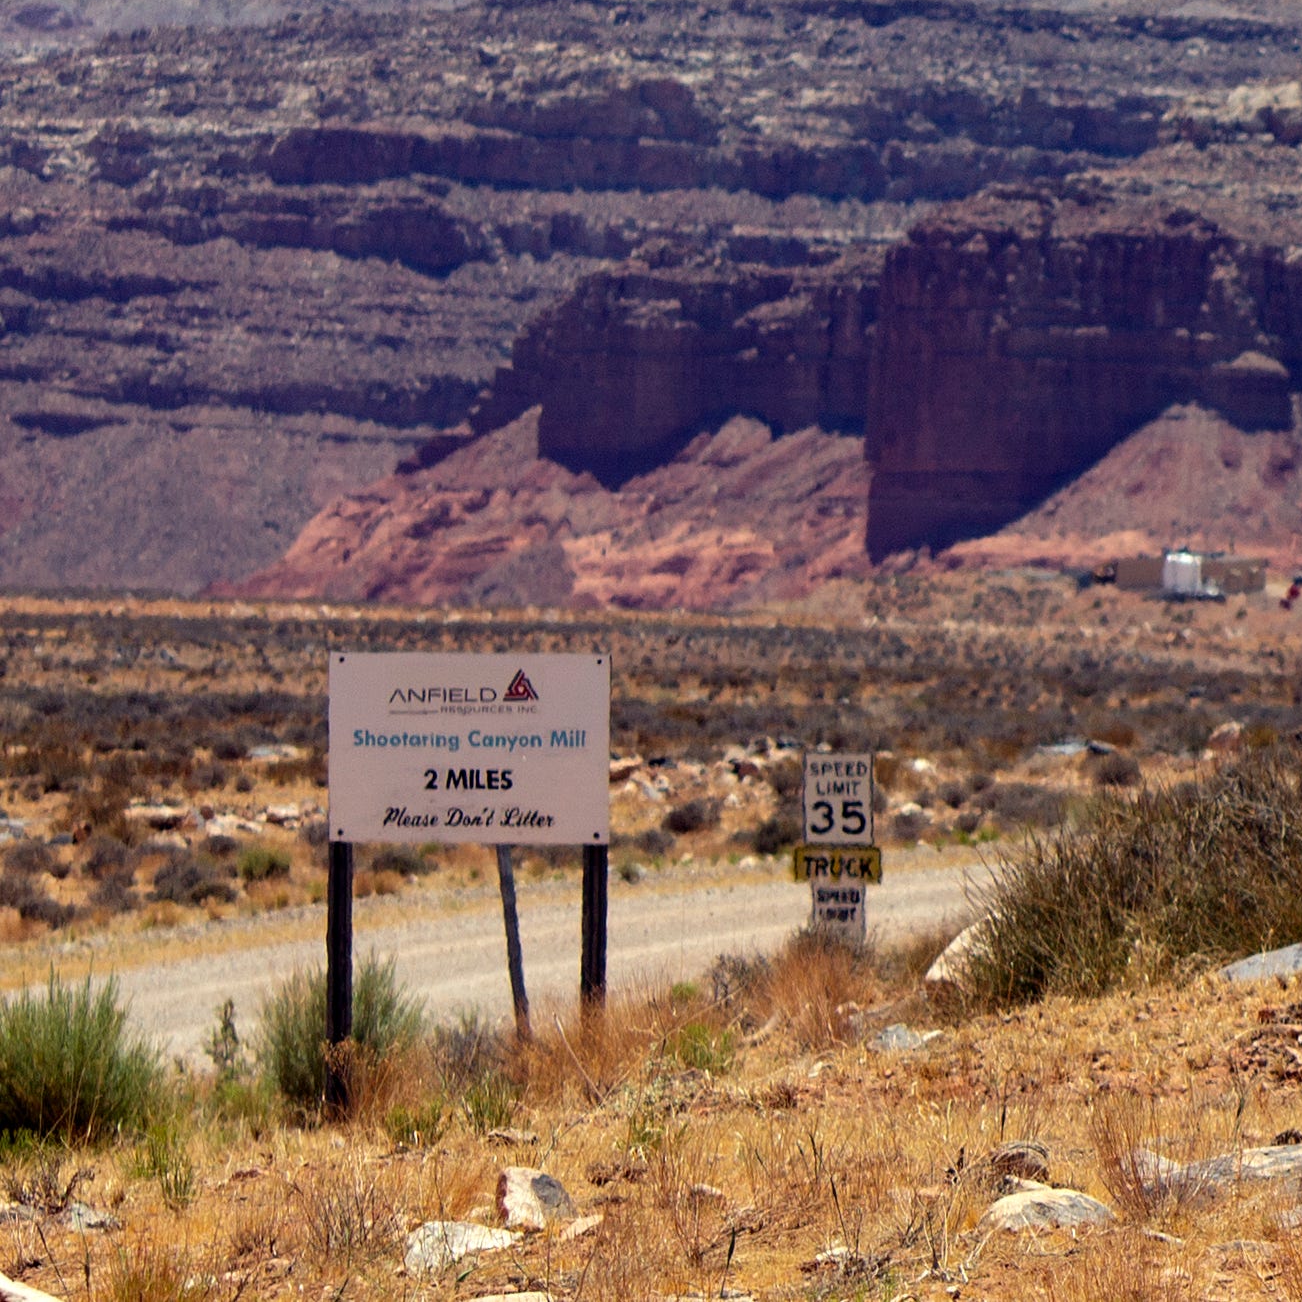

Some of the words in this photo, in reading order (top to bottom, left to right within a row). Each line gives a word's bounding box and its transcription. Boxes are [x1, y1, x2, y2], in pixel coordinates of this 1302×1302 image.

[389, 687, 498, 704] ANFIELD
[353, 729, 460, 752] Shootaring
[468, 730, 543, 753] Canyon
[550, 730, 586, 748] Mill
[423, 769, 438, 790] 2
[446, 769, 514, 790] MILES
[810, 761, 867, 777] SPEED
[816, 781, 861, 797] LIMIT
[383, 807, 439, 828] Please
[444, 807, 495, 828] Don't
[499, 807, 556, 828] Litter
[810, 801, 866, 834] 35
[804, 857, 872, 878] TRUCK
